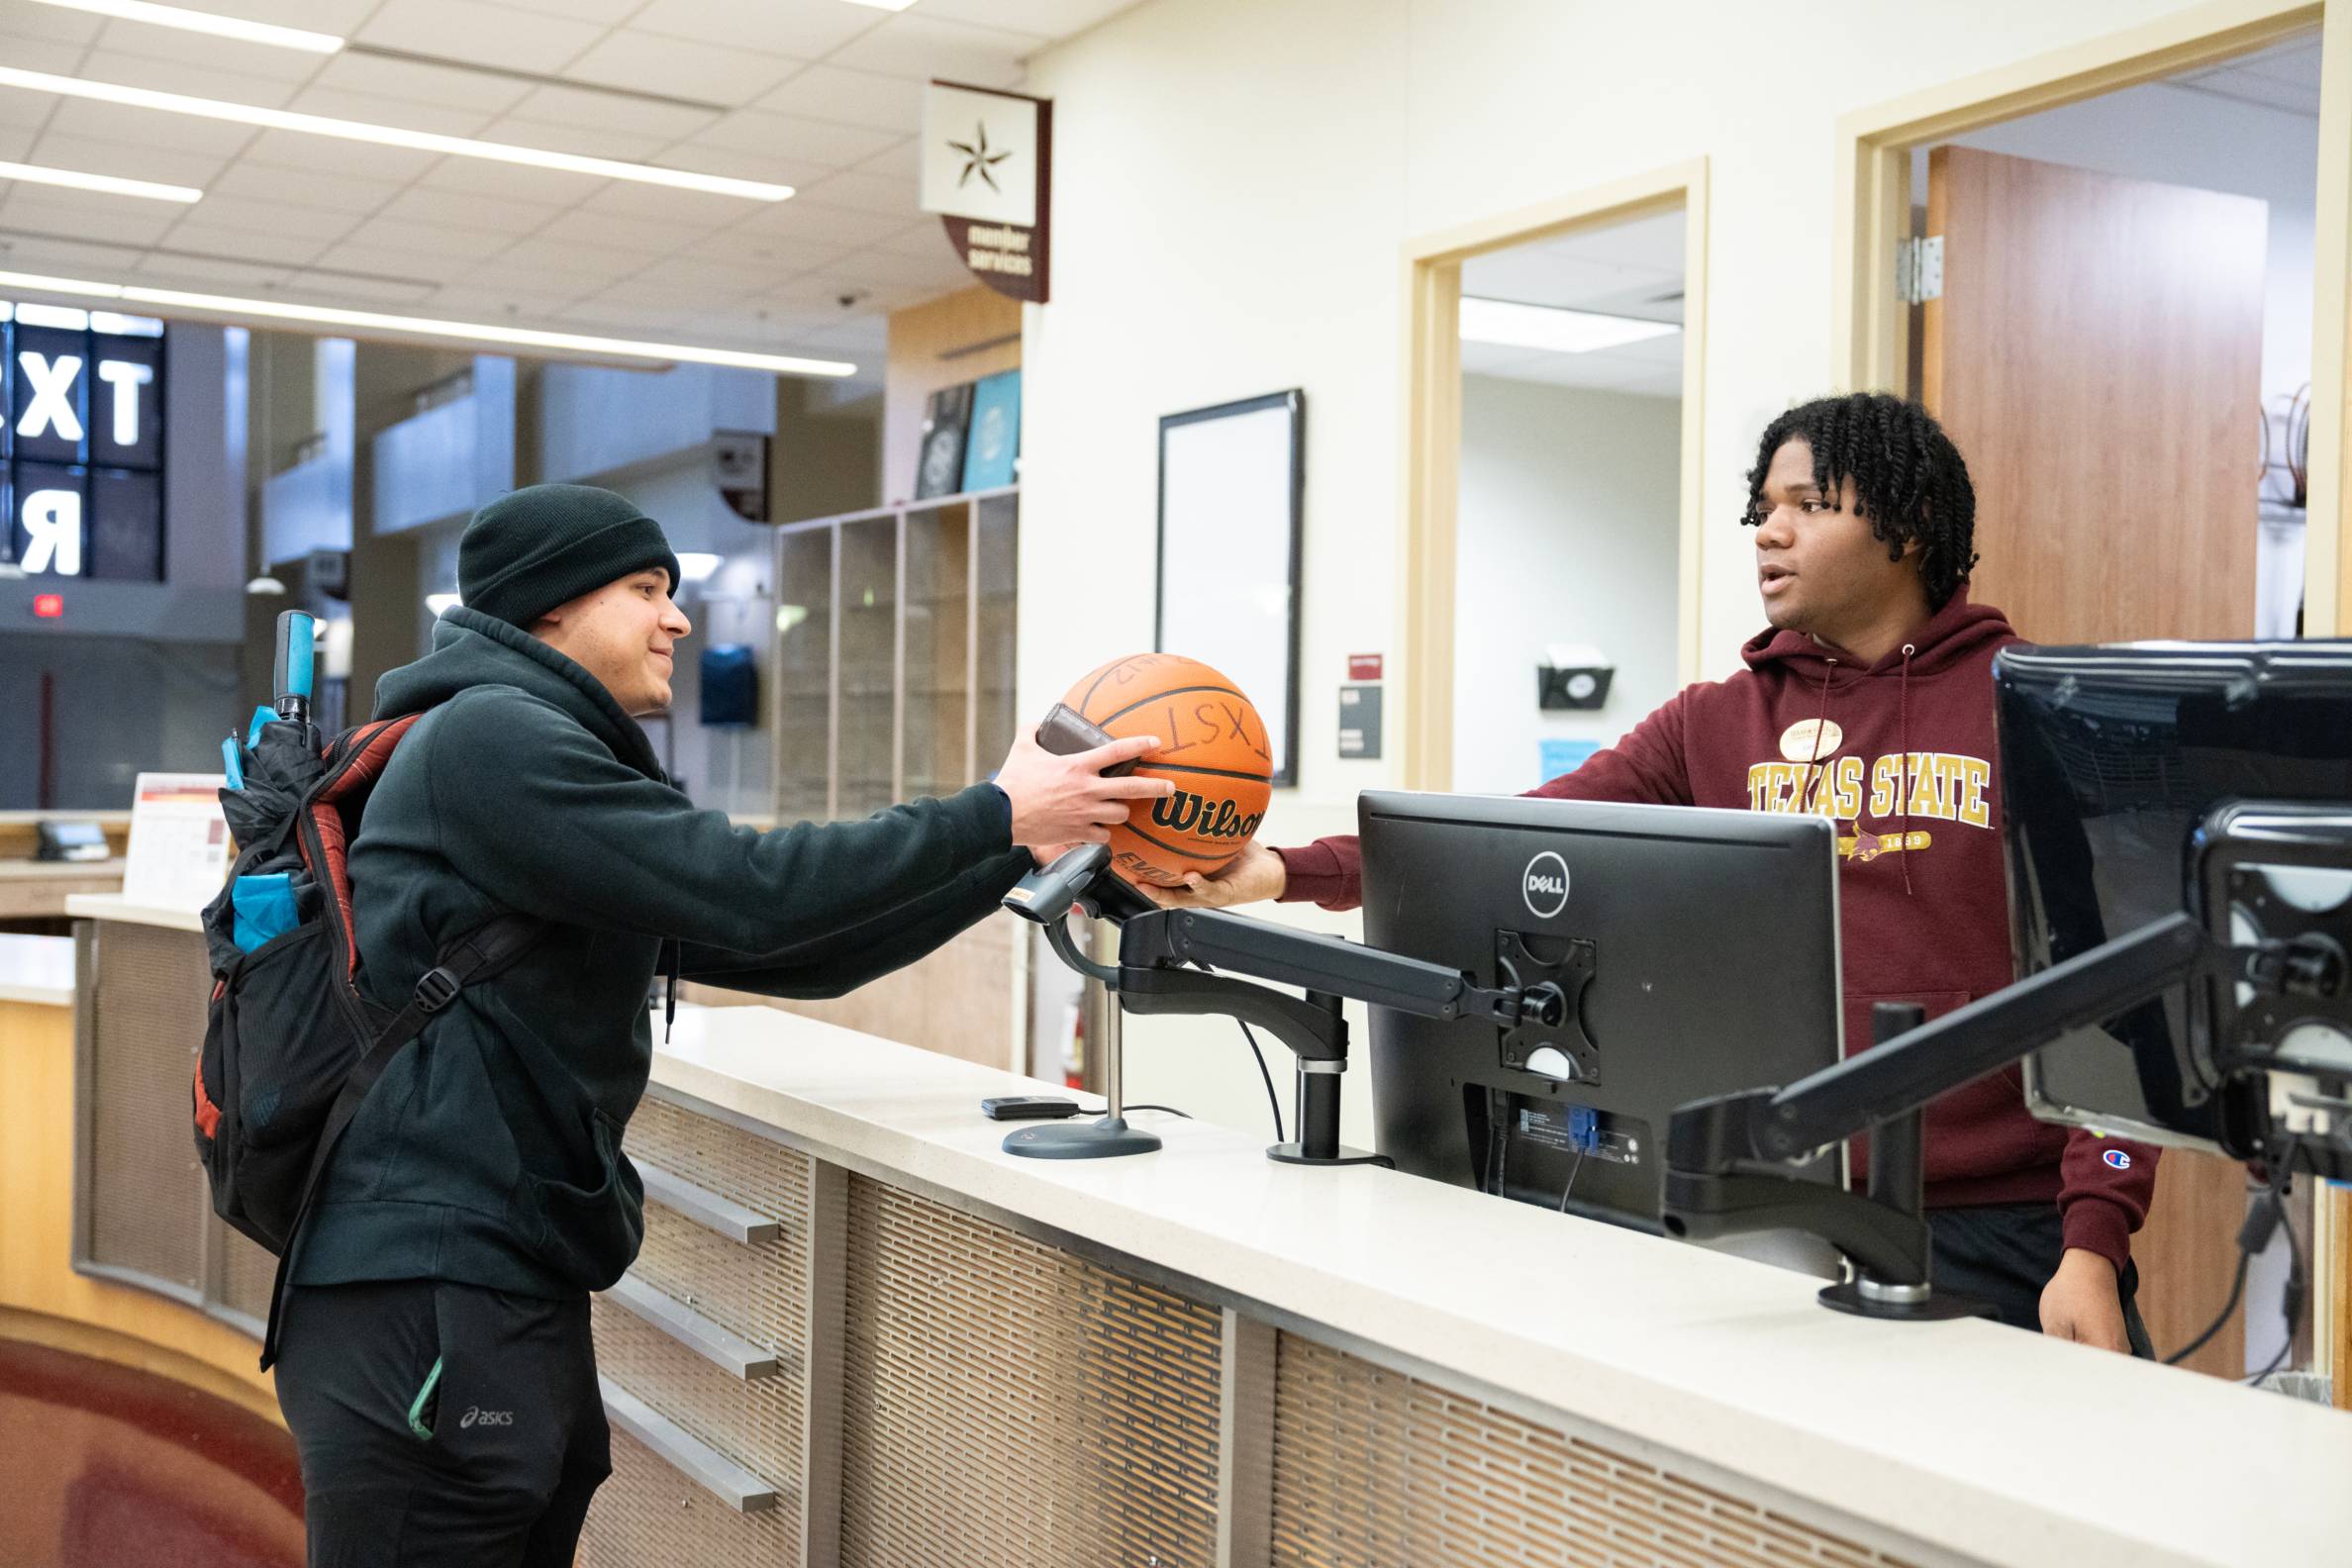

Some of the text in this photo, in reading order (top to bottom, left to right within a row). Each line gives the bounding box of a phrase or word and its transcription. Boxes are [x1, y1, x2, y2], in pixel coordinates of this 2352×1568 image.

[967, 248, 1032, 276] services
[1747, 752, 1991, 830] TEXAS STATE
[1527, 874, 1564, 894] DELL
[477, 1410, 514, 1426] asics
